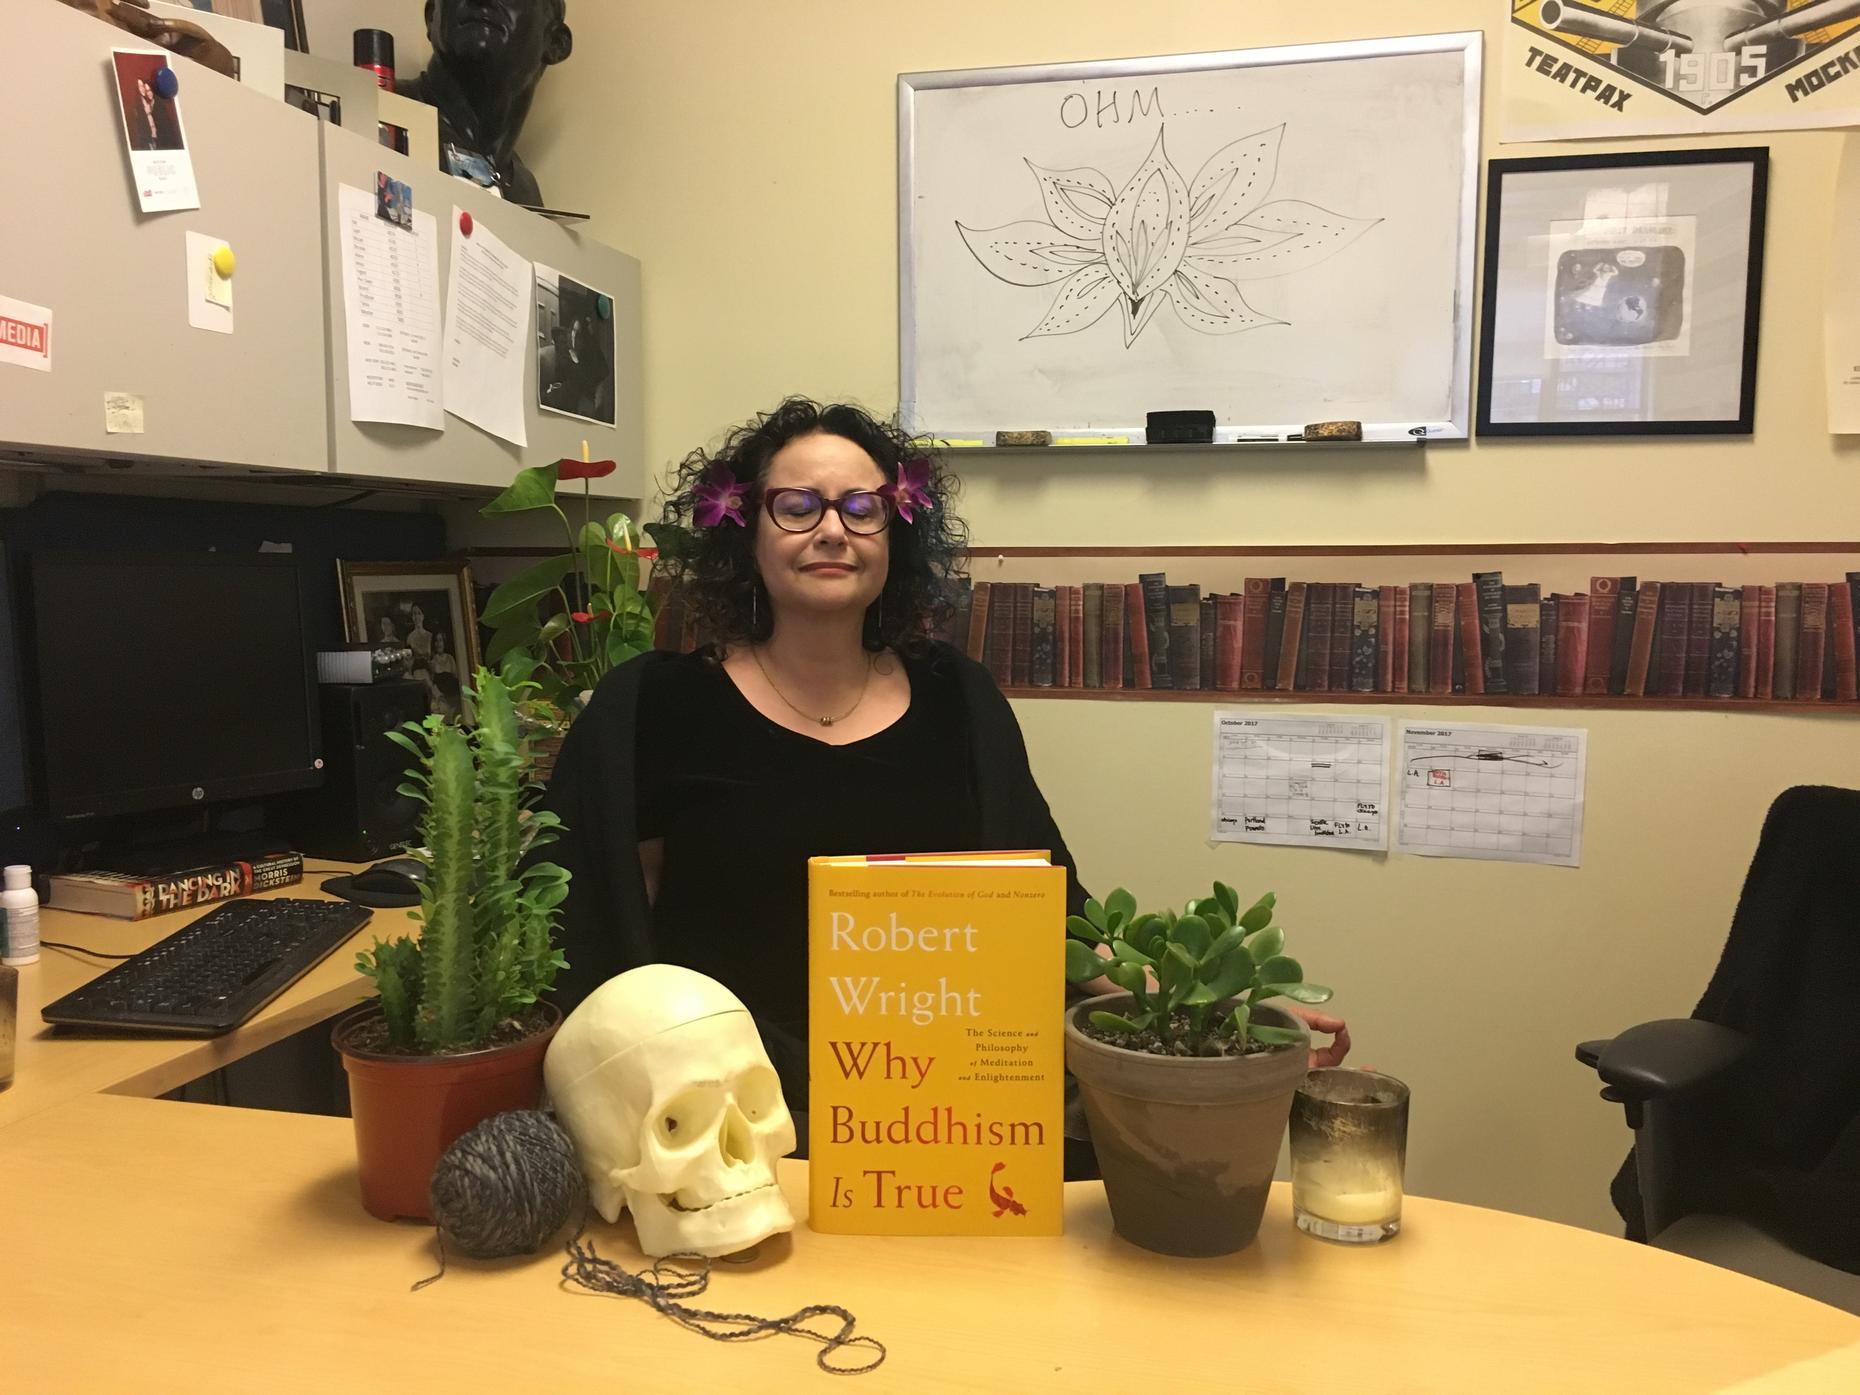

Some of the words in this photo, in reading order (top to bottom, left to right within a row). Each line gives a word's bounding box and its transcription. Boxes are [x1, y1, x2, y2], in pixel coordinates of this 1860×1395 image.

[1526, 46, 1632, 112] ТЕАТРАХ
[1660, 45, 1768, 92] 1905
[1406, 729, 1436, 737] November
[158, 872, 223, 894] DANCING
[225, 868, 241, 885] IN
[254, 868, 288, 881] MORRIS
[254, 874, 299, 889] DICKSTEIN
[159, 890, 193, 909] THE
[196, 879, 242, 903] DARK
[829, 889, 870, 900] Bestselling
[872, 890, 898, 898] author
[900, 890, 909, 898] of
[911, 889, 925, 898] The
[928, 890, 967, 898] Evolution
[968, 890, 976, 900] of
[977, 891, 993, 899] God
[996, 891, 1011, 899] and
[1013, 891, 1045, 899] Nonzero
[831, 911, 978, 952] Robert
[829, 976, 981, 1026] Wright
[966, 1028, 984, 1037] The
[987, 1028, 1023, 1037] Science
[976, 1043, 1029, 1054] Philosophy
[828, 1040, 936, 1089] Why
[980, 1058, 1033, 1067] Meditation
[975, 1073, 1045, 1083] Enlightenment
[830, 1105, 1045, 1146] Buddhism
[830, 1176, 853, 1209] Is
[863, 1169, 964, 1210] True
